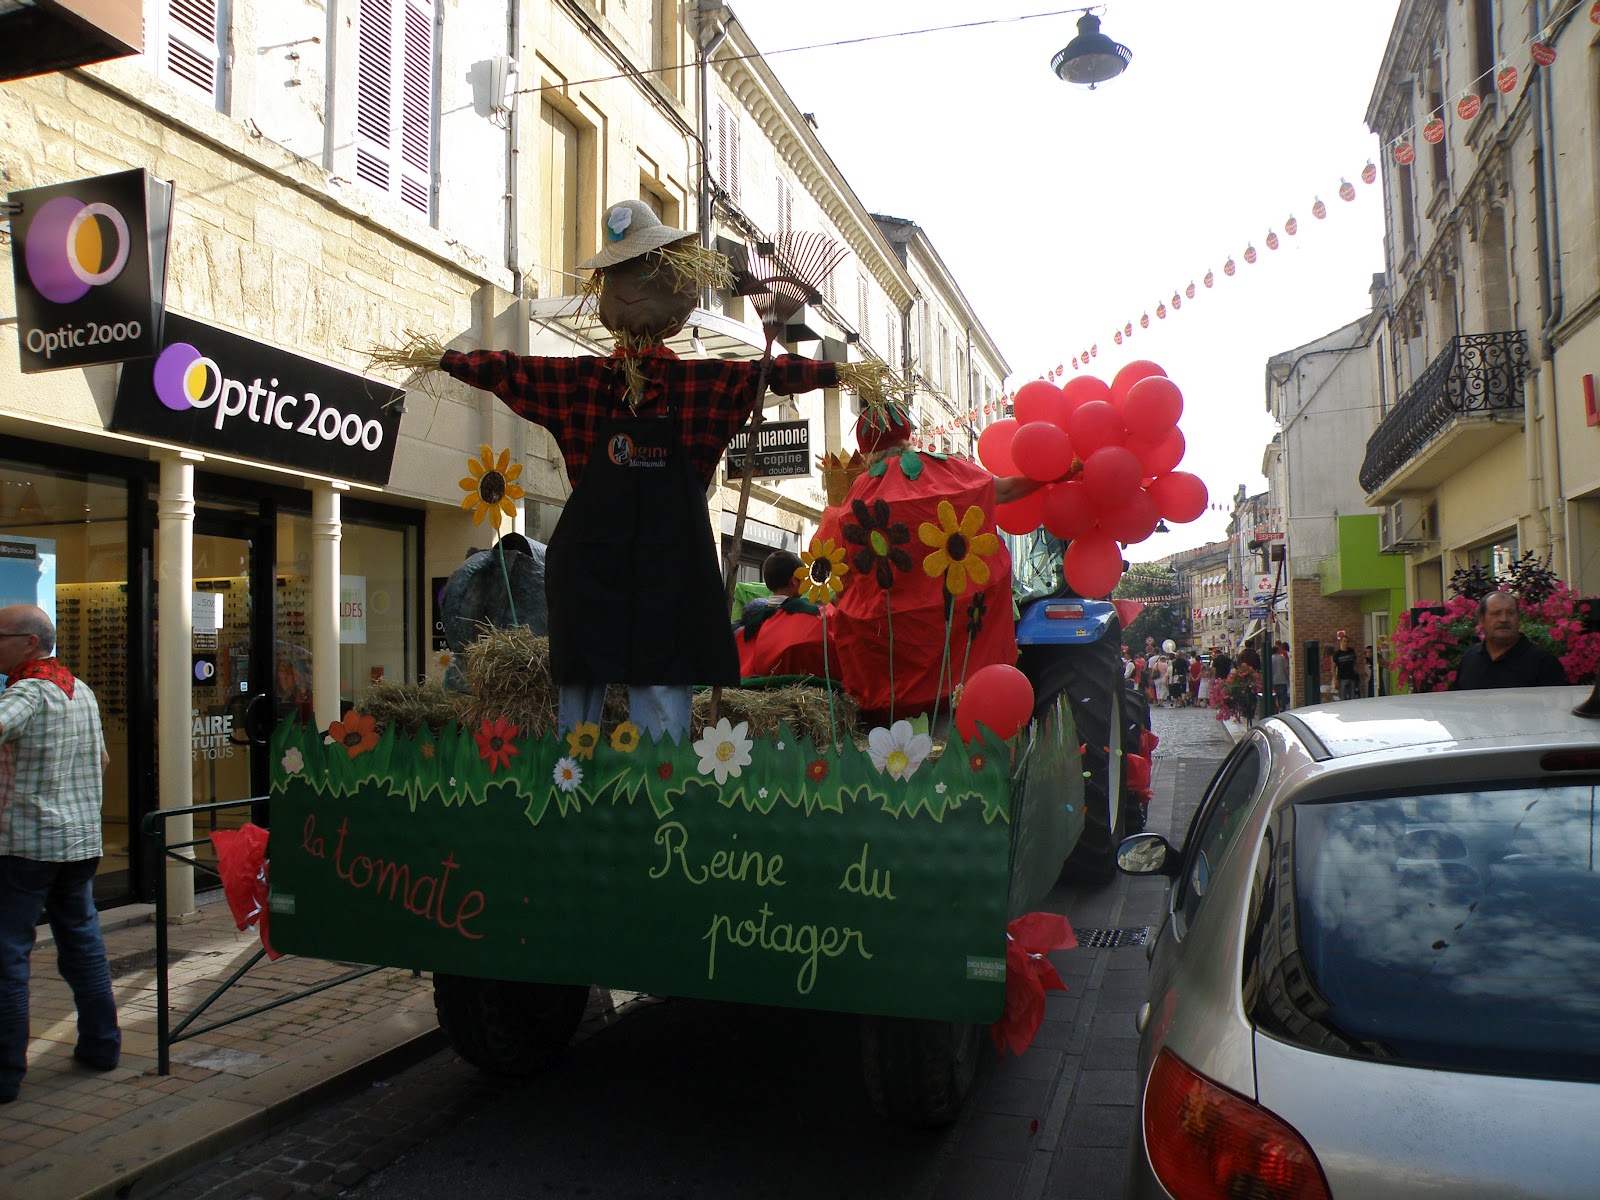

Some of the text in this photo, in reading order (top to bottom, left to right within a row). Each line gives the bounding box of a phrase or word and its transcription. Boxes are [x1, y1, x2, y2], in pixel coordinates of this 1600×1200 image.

[27, 321, 142, 358] Optic 2000
[183, 356, 383, 452] Optic 2000
[764, 452, 802, 466] copine
[768, 465, 794, 475] double
[794, 465, 806, 474] jeu
[340, 602, 363, 618] LDES
[192, 715, 234, 736] AIRE
[192, 734, 231, 749] TUITE
[202, 747, 234, 760] TOUS
[649, 820, 896, 900] Reine du
[301, 814, 325, 859] la
[333, 816, 486, 940] tomate
[702, 902, 874, 995] potager
